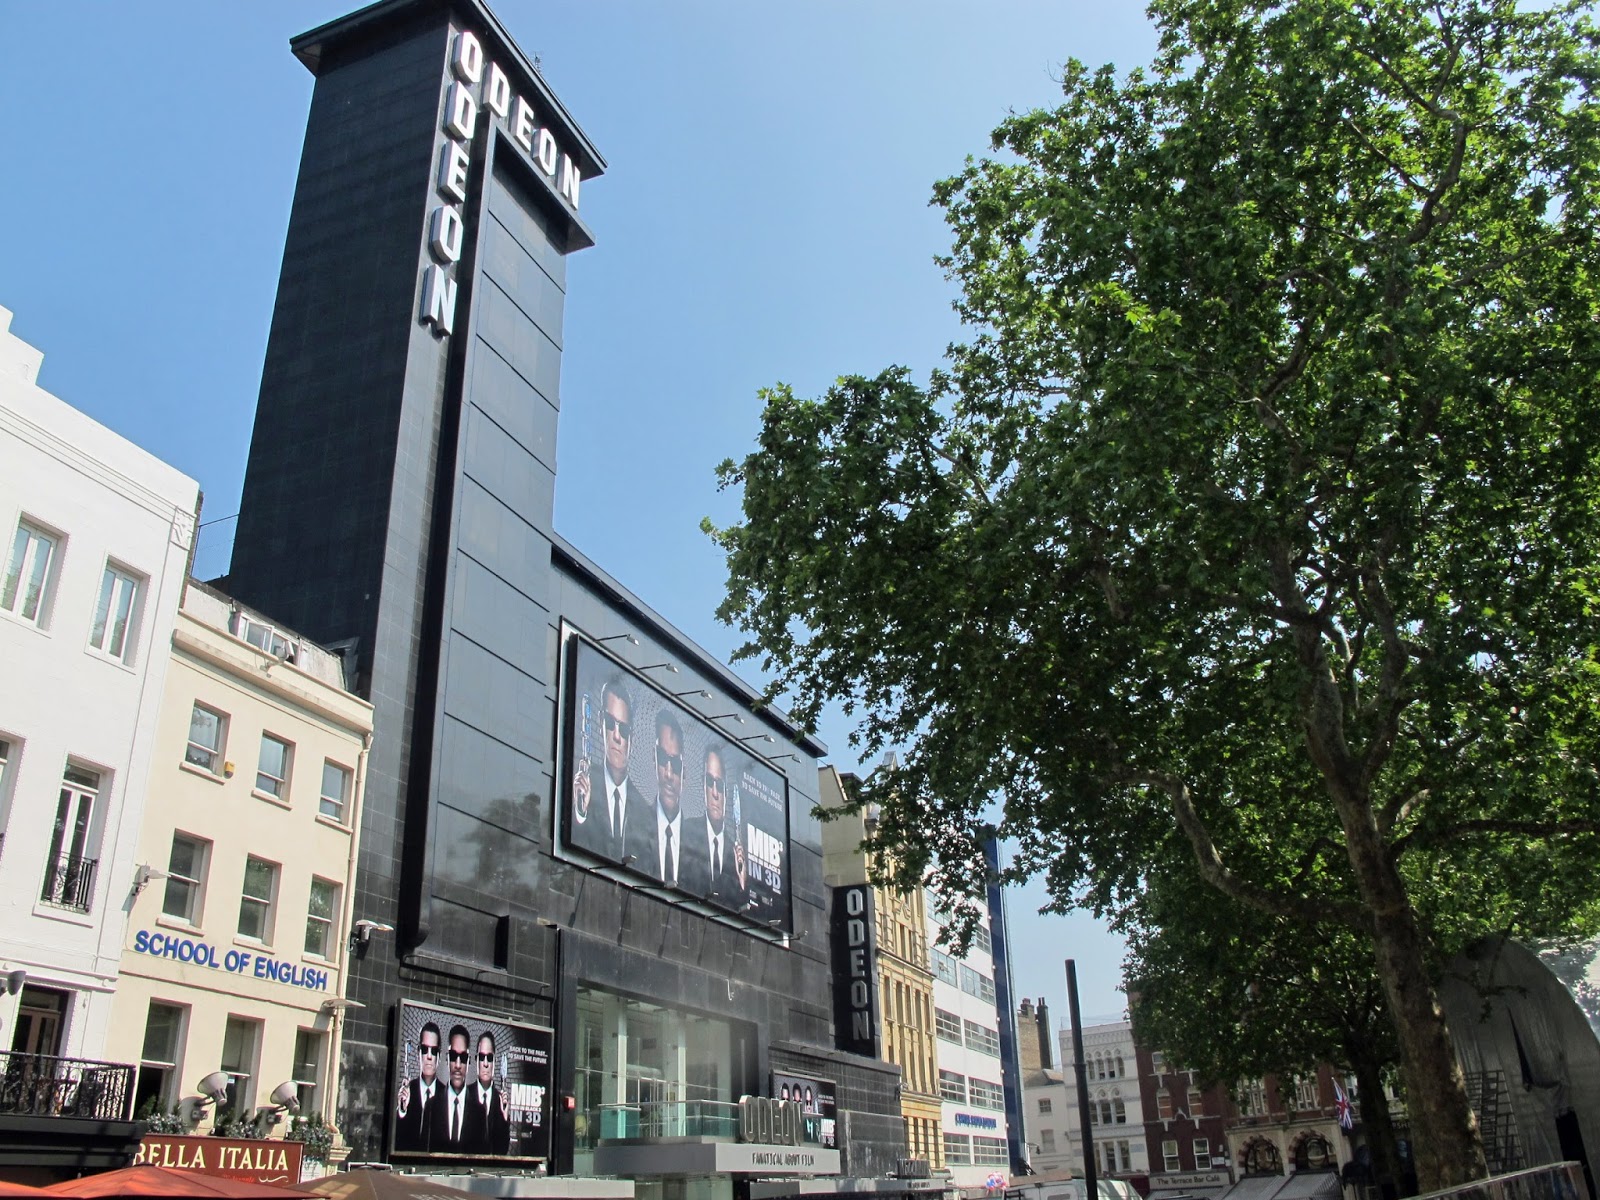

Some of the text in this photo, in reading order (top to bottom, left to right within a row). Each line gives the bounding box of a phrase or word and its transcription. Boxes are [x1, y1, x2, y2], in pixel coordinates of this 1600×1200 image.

[452, 30, 581, 211] ODEON
[421, 30, 483, 337] ODEON
[747, 860, 781, 890] IN 3D
[134, 930, 328, 990] SCHOOL OF ENGLISH
[846, 888, 870, 1040] ODEON
[510, 1110, 542, 1124] IN 3D
[133, 1143, 288, 1171] BELLA ITALIA
[752, 1152, 815, 1166] FANATICAL ABOUT FILM
[1157, 1174, 1220, 1185] The Terrace Bar Café
